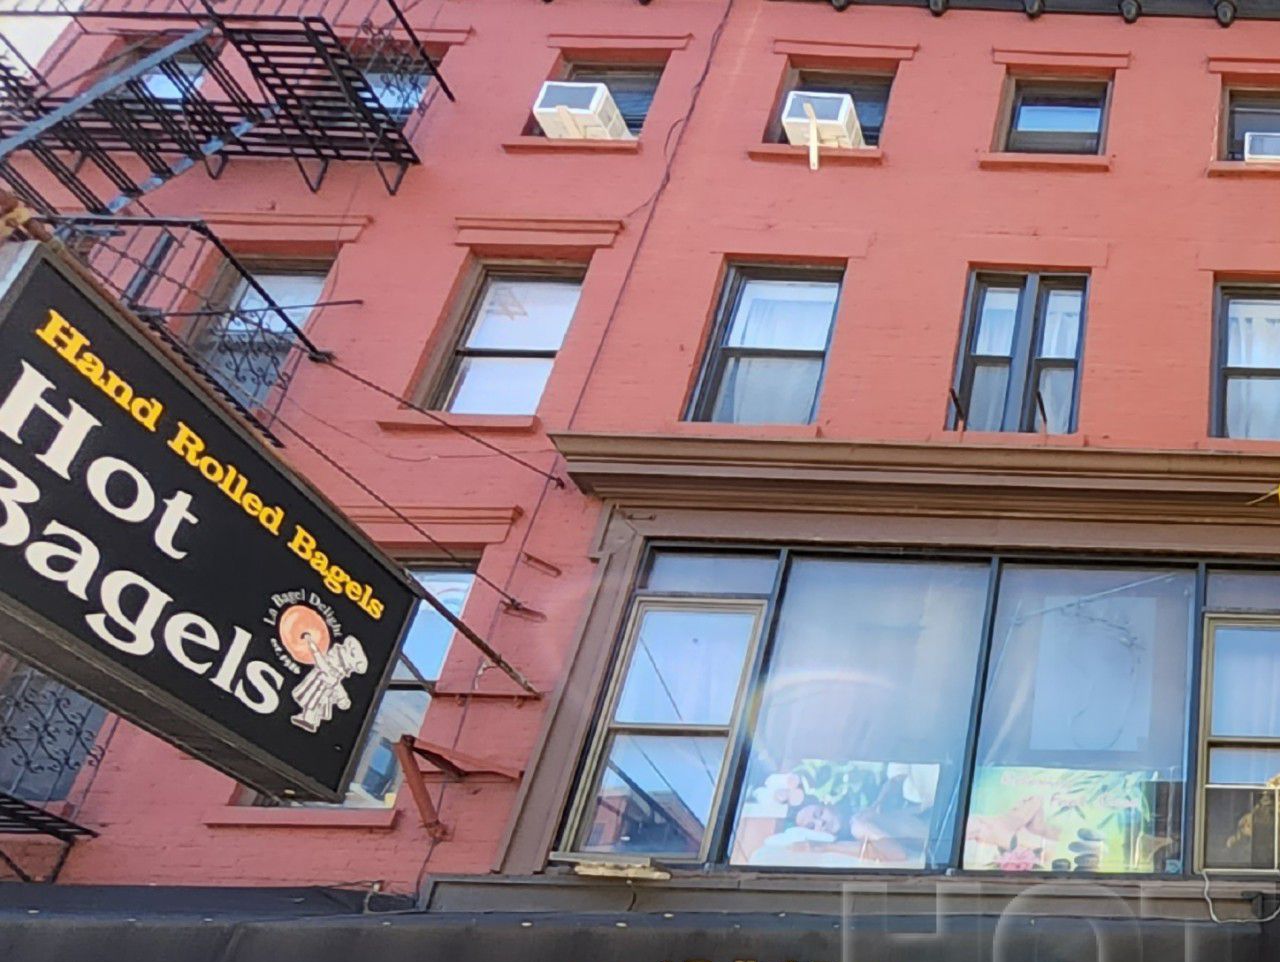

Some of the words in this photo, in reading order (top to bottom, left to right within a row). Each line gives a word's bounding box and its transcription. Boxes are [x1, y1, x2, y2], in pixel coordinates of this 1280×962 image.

[0, 359, 199, 560] Hot
[36, 309, 162, 432] Hand
[167, 421, 285, 535] Rolled
[287, 525, 385, 620] Bagels
